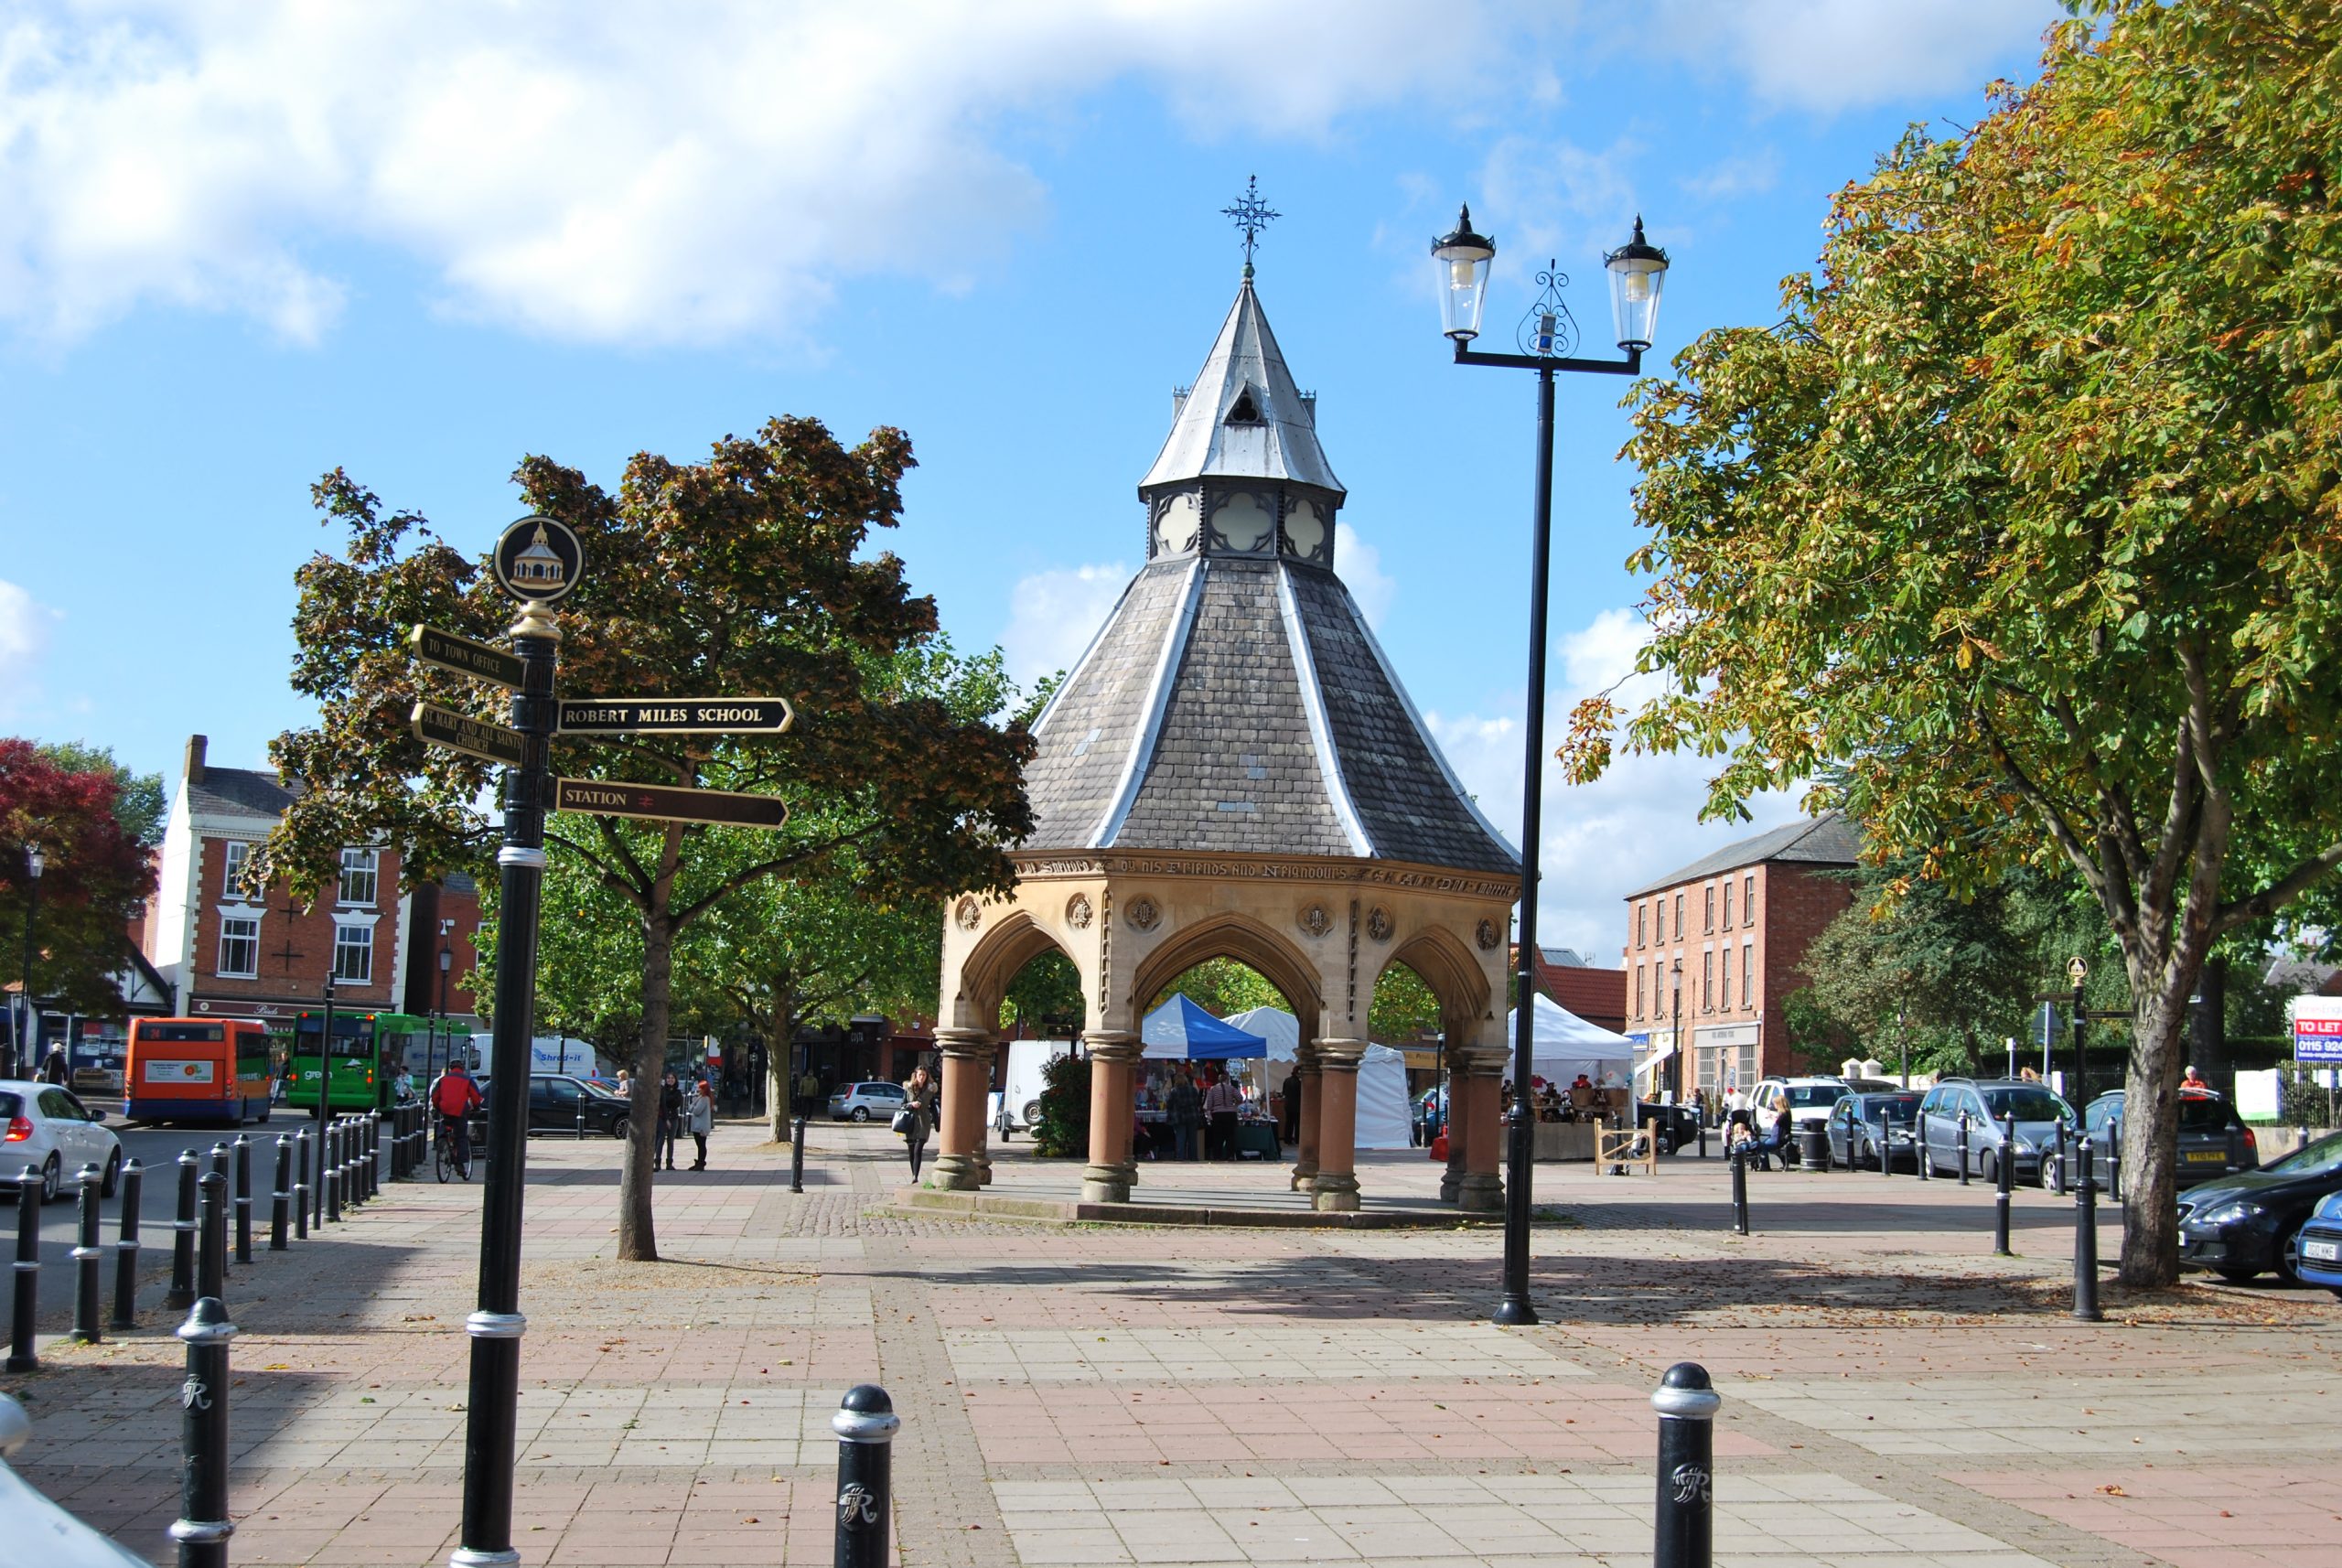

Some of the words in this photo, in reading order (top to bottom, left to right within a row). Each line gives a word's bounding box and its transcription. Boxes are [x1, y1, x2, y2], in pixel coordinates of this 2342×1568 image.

[428, 639, 440, 653] TO
[445, 643, 469, 661] TOWN
[472, 653, 500, 673] OFFICE
[565, 709, 628, 723] ROBERT
[639, 709, 688, 723] MILES
[697, 708, 763, 722] SCHOOL
[435, 712, 457, 731] MARY
[461, 721, 478, 736] AND
[480, 725, 494, 741] ALL
[497, 733, 522, 750] SAINTS
[456, 733, 489, 753] CHURCH
[565, 789, 628, 806] STATION
[1167, 861, 1227, 875] Friends
[2298, 1021, 2315, 1032] TO
[2317, 1022, 2340, 1033] LET
[851, 1031, 864, 1043] COSTA
[2298, 1040, 2323, 1051] 0115
[541, 1053, 582, 1061] Shred-it
[305, 1070, 333, 1080] gren
